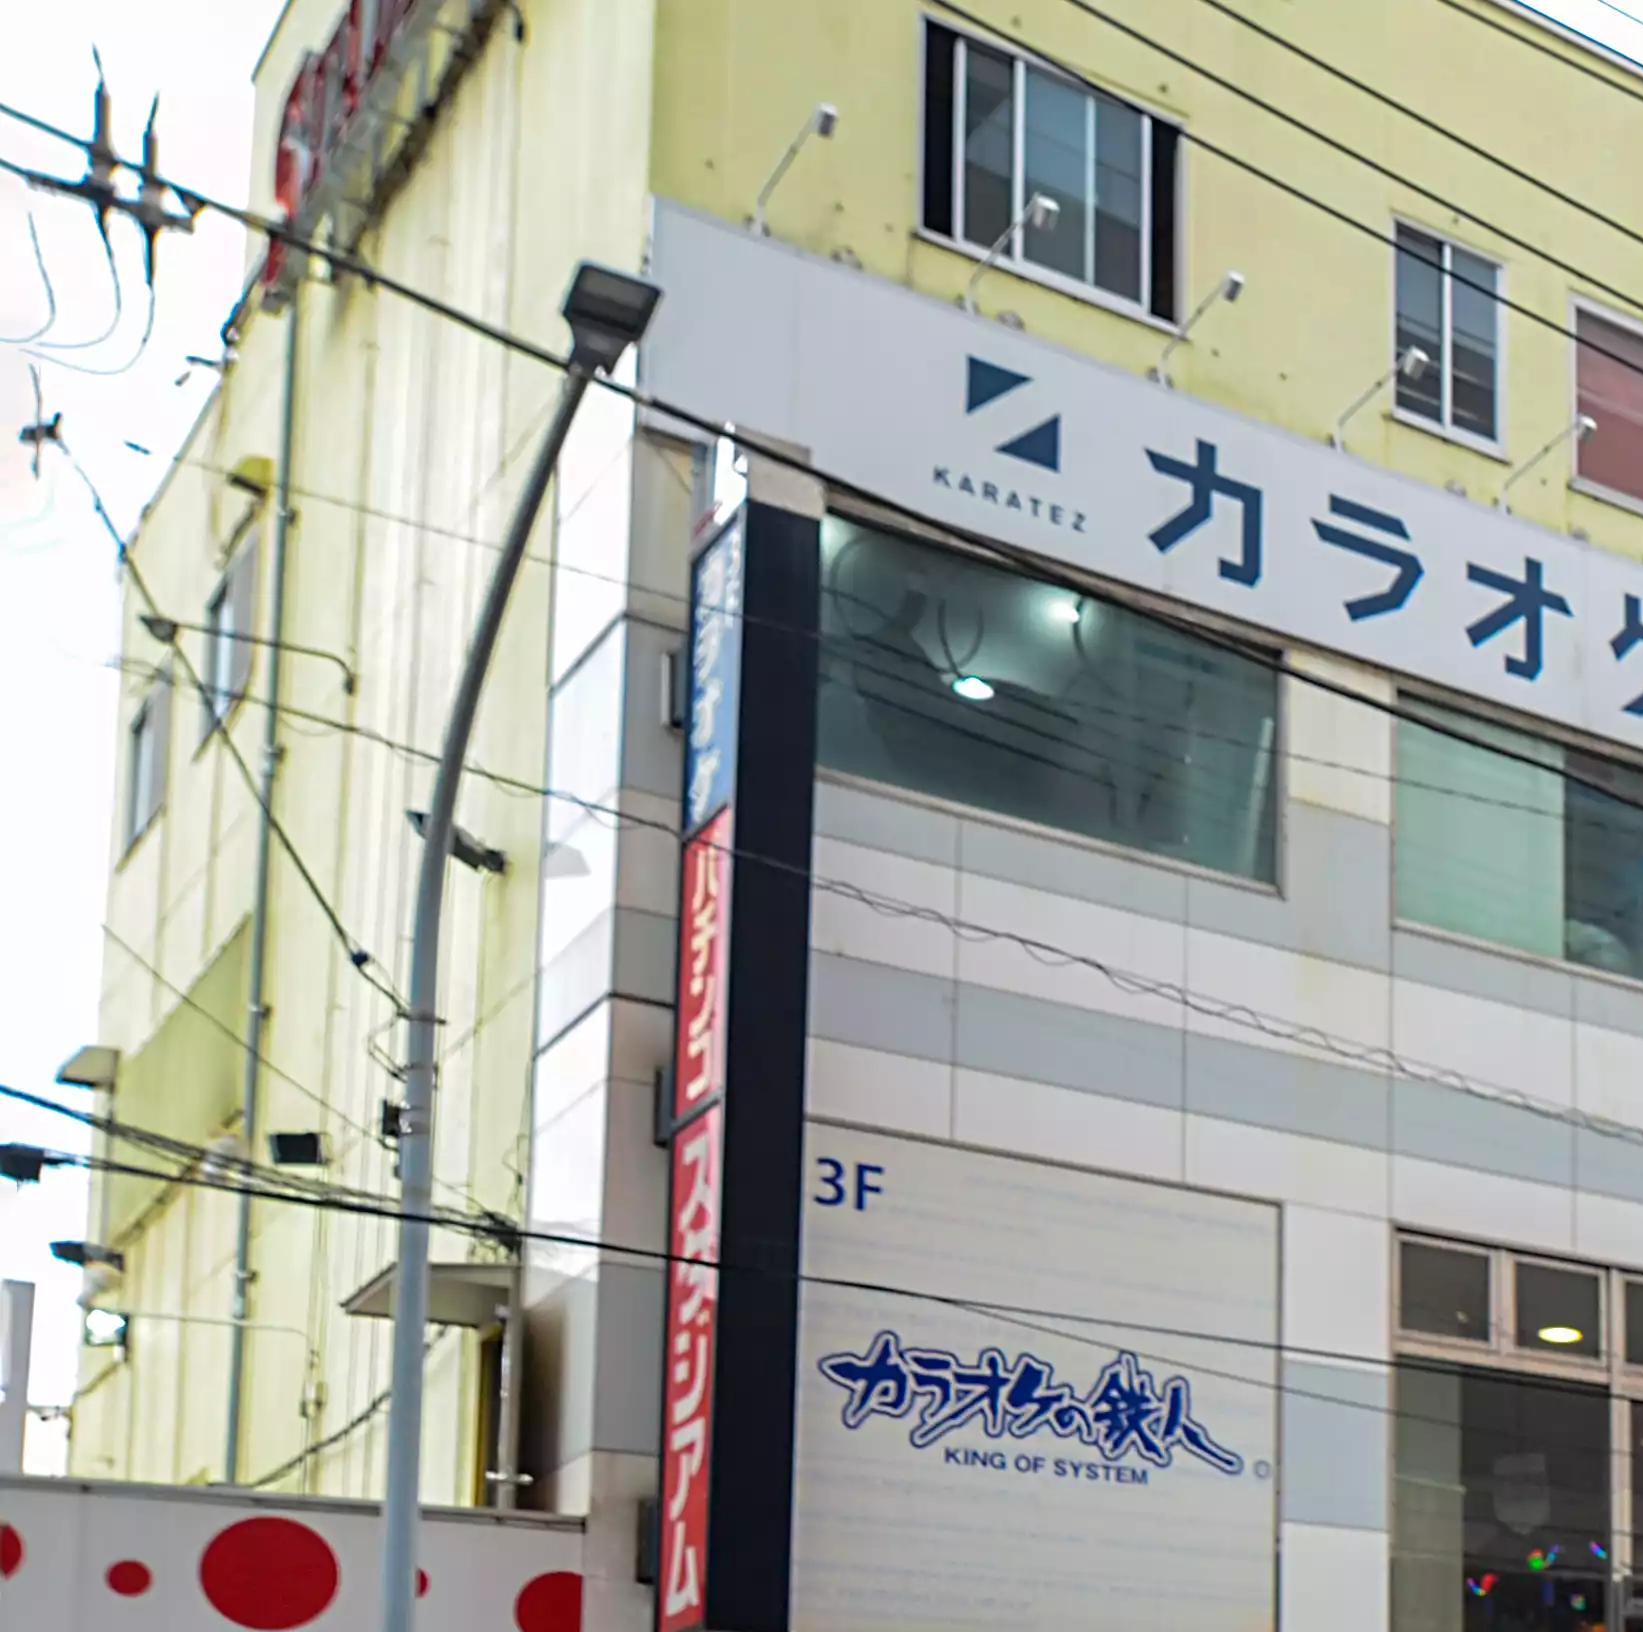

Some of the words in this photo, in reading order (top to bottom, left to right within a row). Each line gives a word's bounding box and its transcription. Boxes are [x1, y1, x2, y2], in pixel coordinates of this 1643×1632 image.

[932, 465, 1088, 534] KARATEZ
[812, 1156, 886, 1212] 3F
[664, 1131, 716, 1618] スタジアム
[817, 1330, 1244, 1476] カラオケの鉄人
[943, 1446, 1008, 1472] KING
[1013, 1453, 1047, 1476] OF
[1052, 1458, 1150, 1487] SYSTEM
